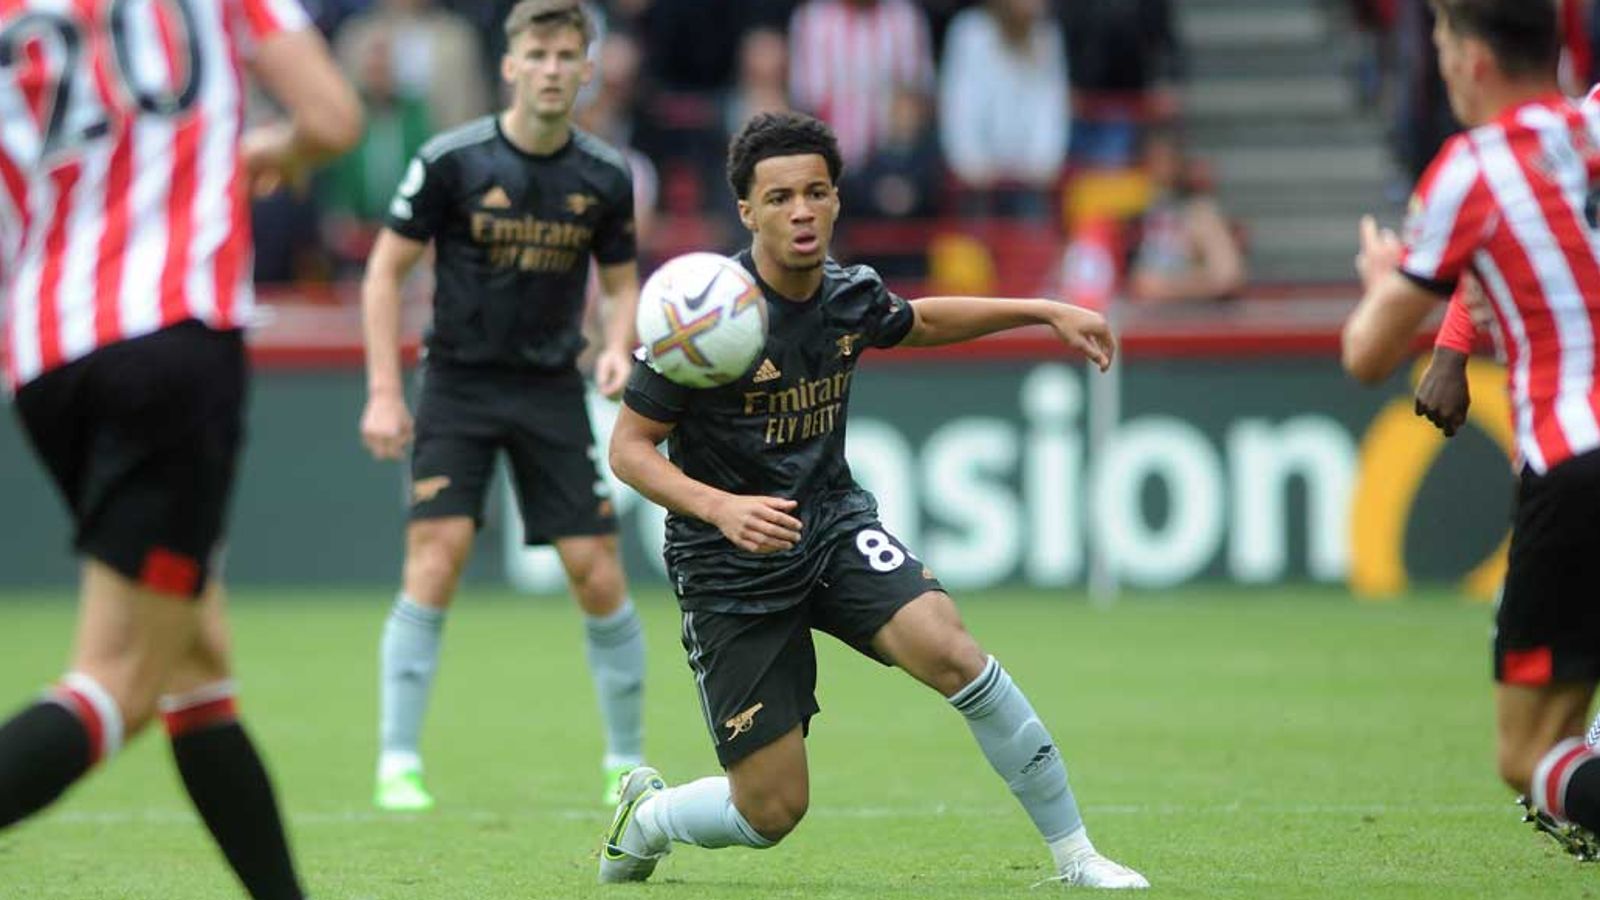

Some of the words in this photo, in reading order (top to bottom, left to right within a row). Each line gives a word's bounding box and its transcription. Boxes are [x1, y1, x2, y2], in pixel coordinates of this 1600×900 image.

[0, 0, 203, 166] 20
[765, 416, 798, 444] FLY
[856, 529, 917, 572] 8
